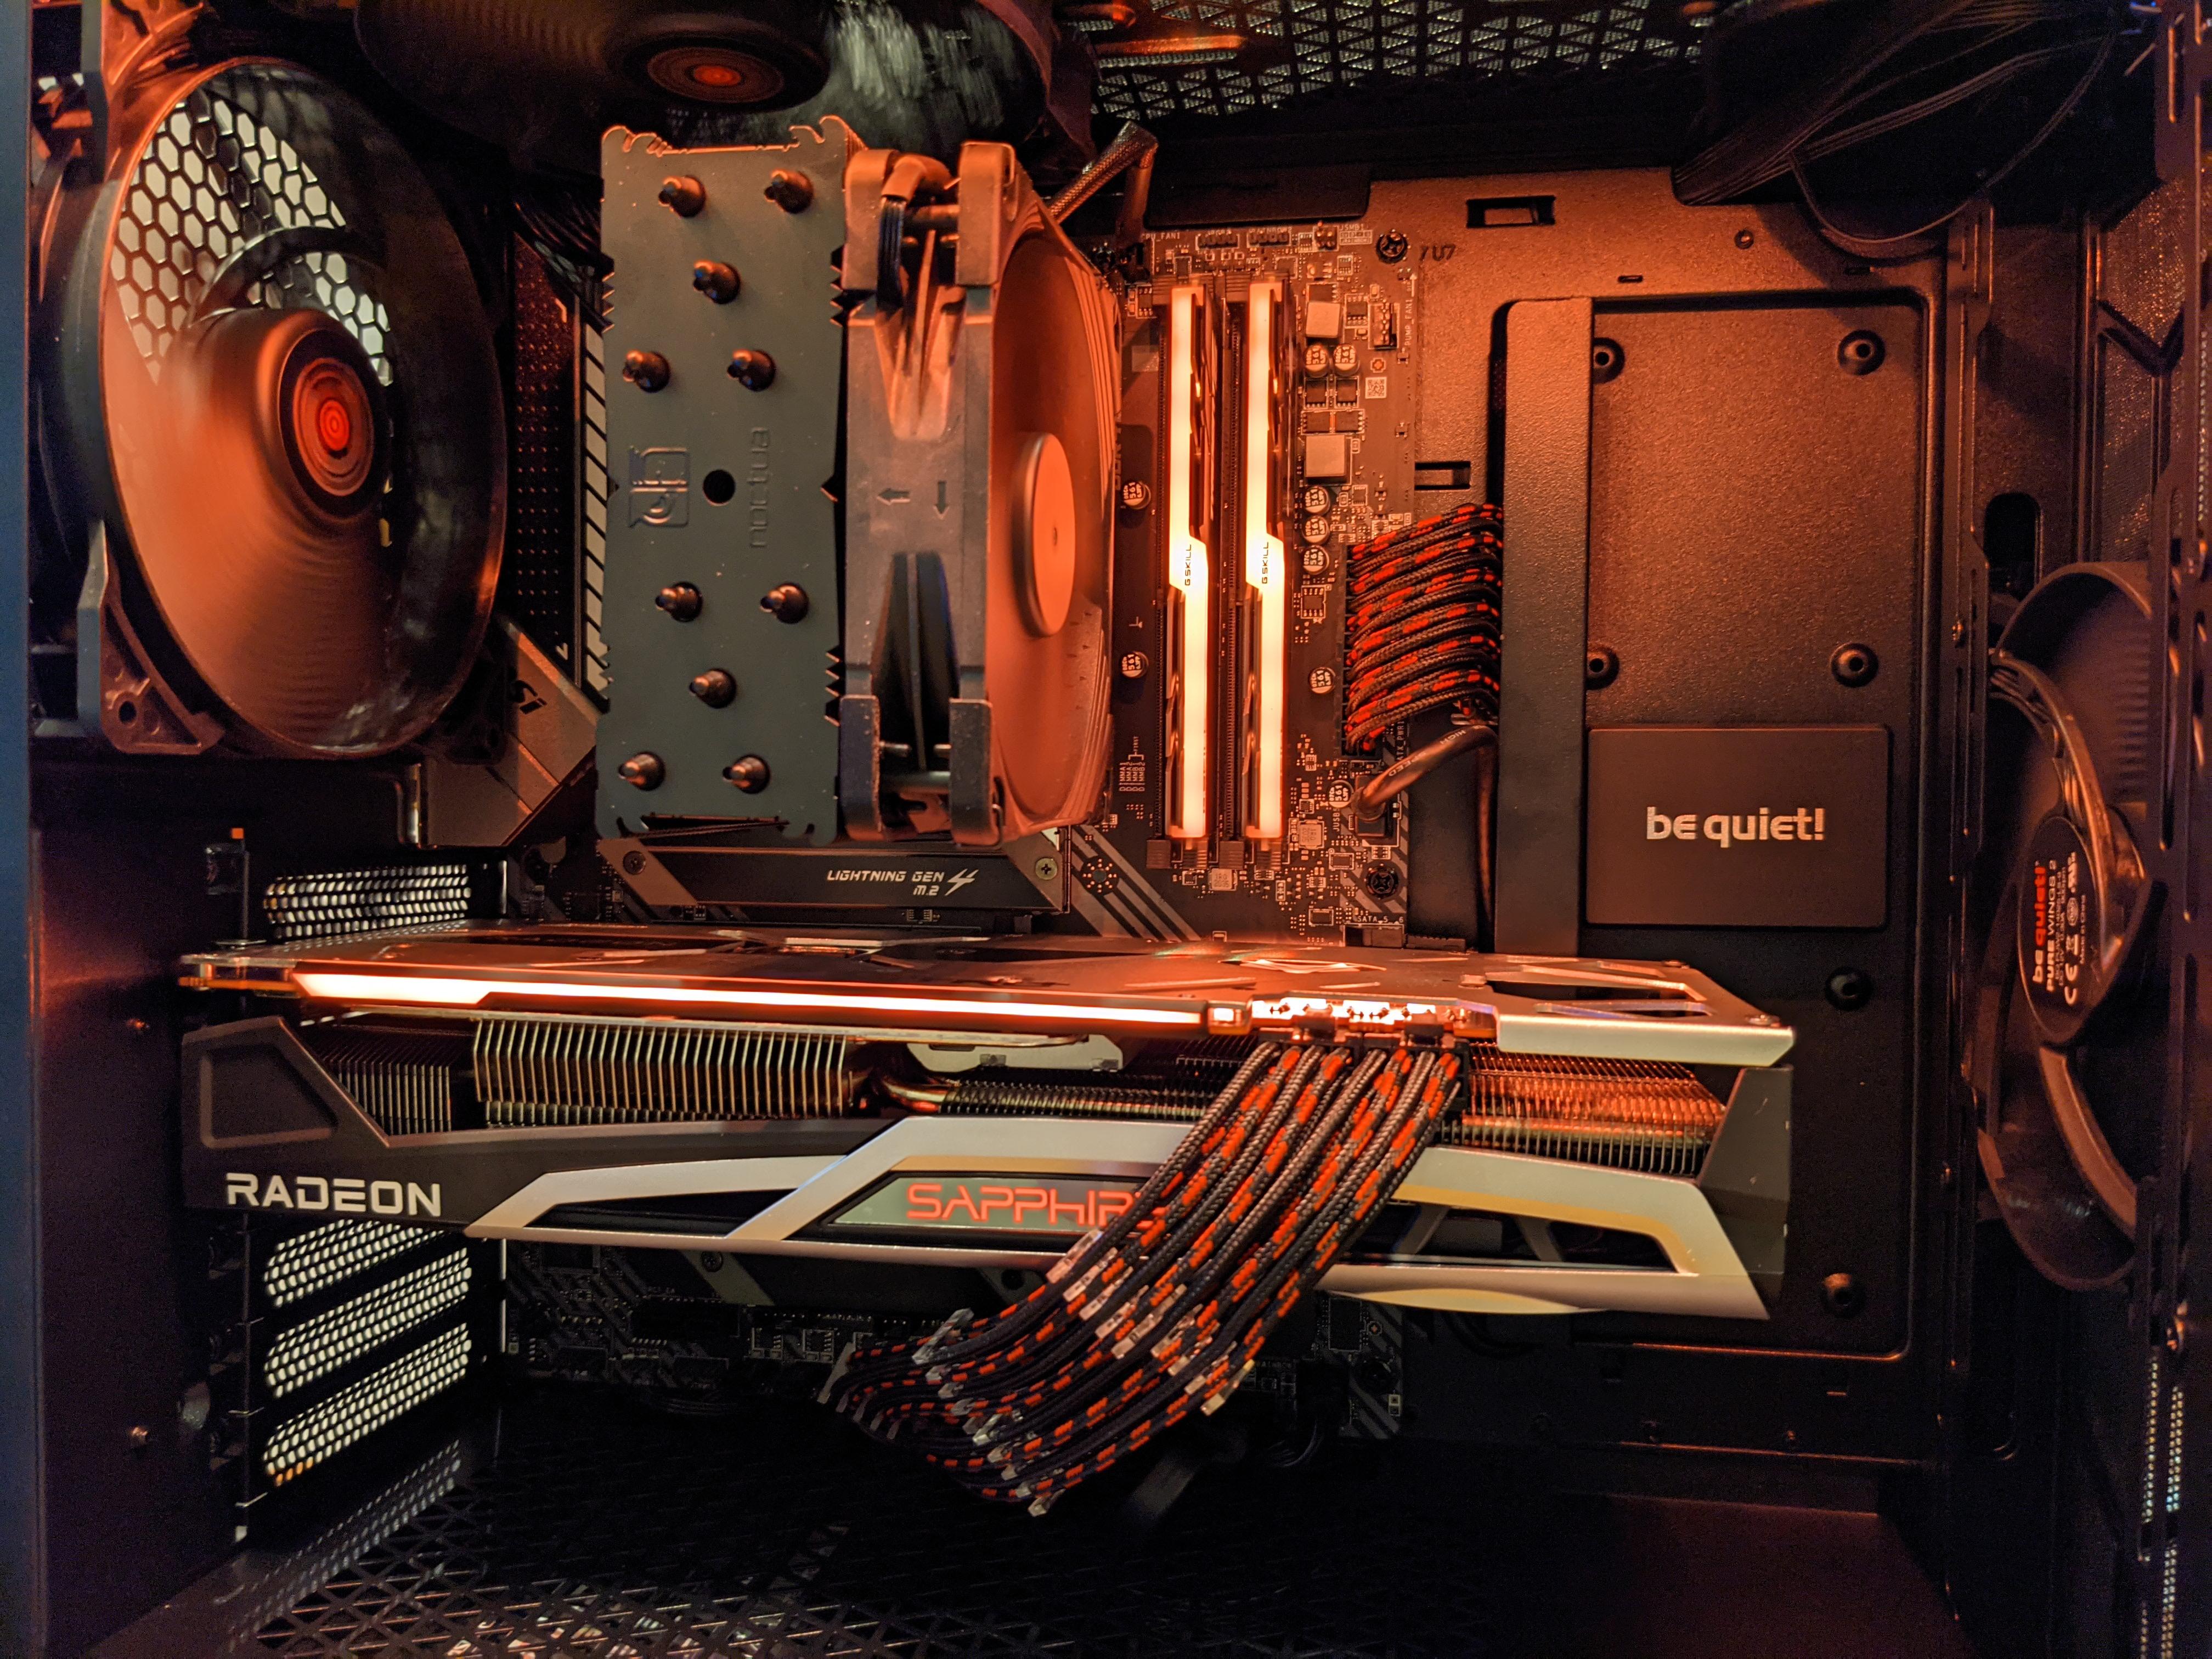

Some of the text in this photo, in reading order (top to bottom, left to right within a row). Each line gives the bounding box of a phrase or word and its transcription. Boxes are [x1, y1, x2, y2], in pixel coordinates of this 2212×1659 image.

[1404, 299, 1414, 346] PUMP_FAN1
[1440, 729, 1467, 744] HIGH
[1647, 806, 1825, 848] be quiet!
[826, 870, 945, 883] LIGHTNING GEN
[913, 885, 940, 896] M.2
[2032, 867, 2045, 983] be quiet!
[2046, 940, 2055, 991] PURE
[225, 1172, 441, 1217] RADEON
[906, 1182, 1154, 1229] SAPPHIR
